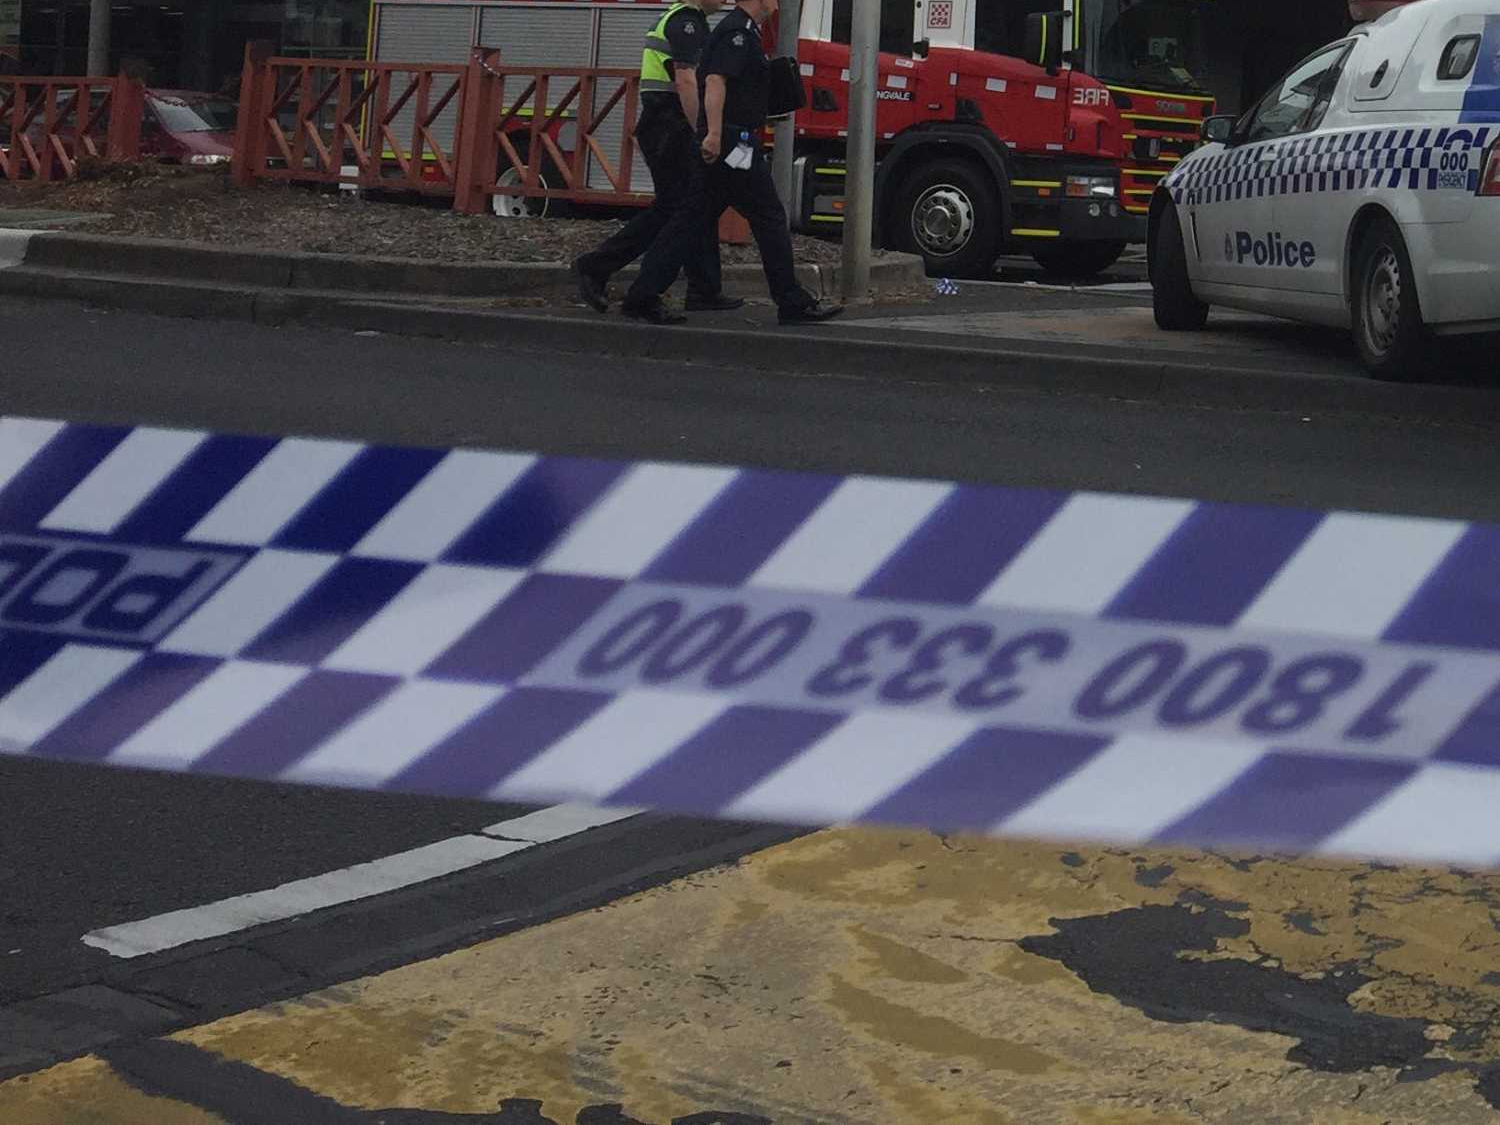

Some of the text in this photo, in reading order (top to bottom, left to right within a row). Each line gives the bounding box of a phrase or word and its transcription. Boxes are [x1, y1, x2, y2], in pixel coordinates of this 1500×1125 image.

[930, 16, 948, 26] CFA
[1440, 152, 1468, 172] 000
[1235, 231, 1316, 268] Police
[577, 597, 1439, 743] 1800 333 000
